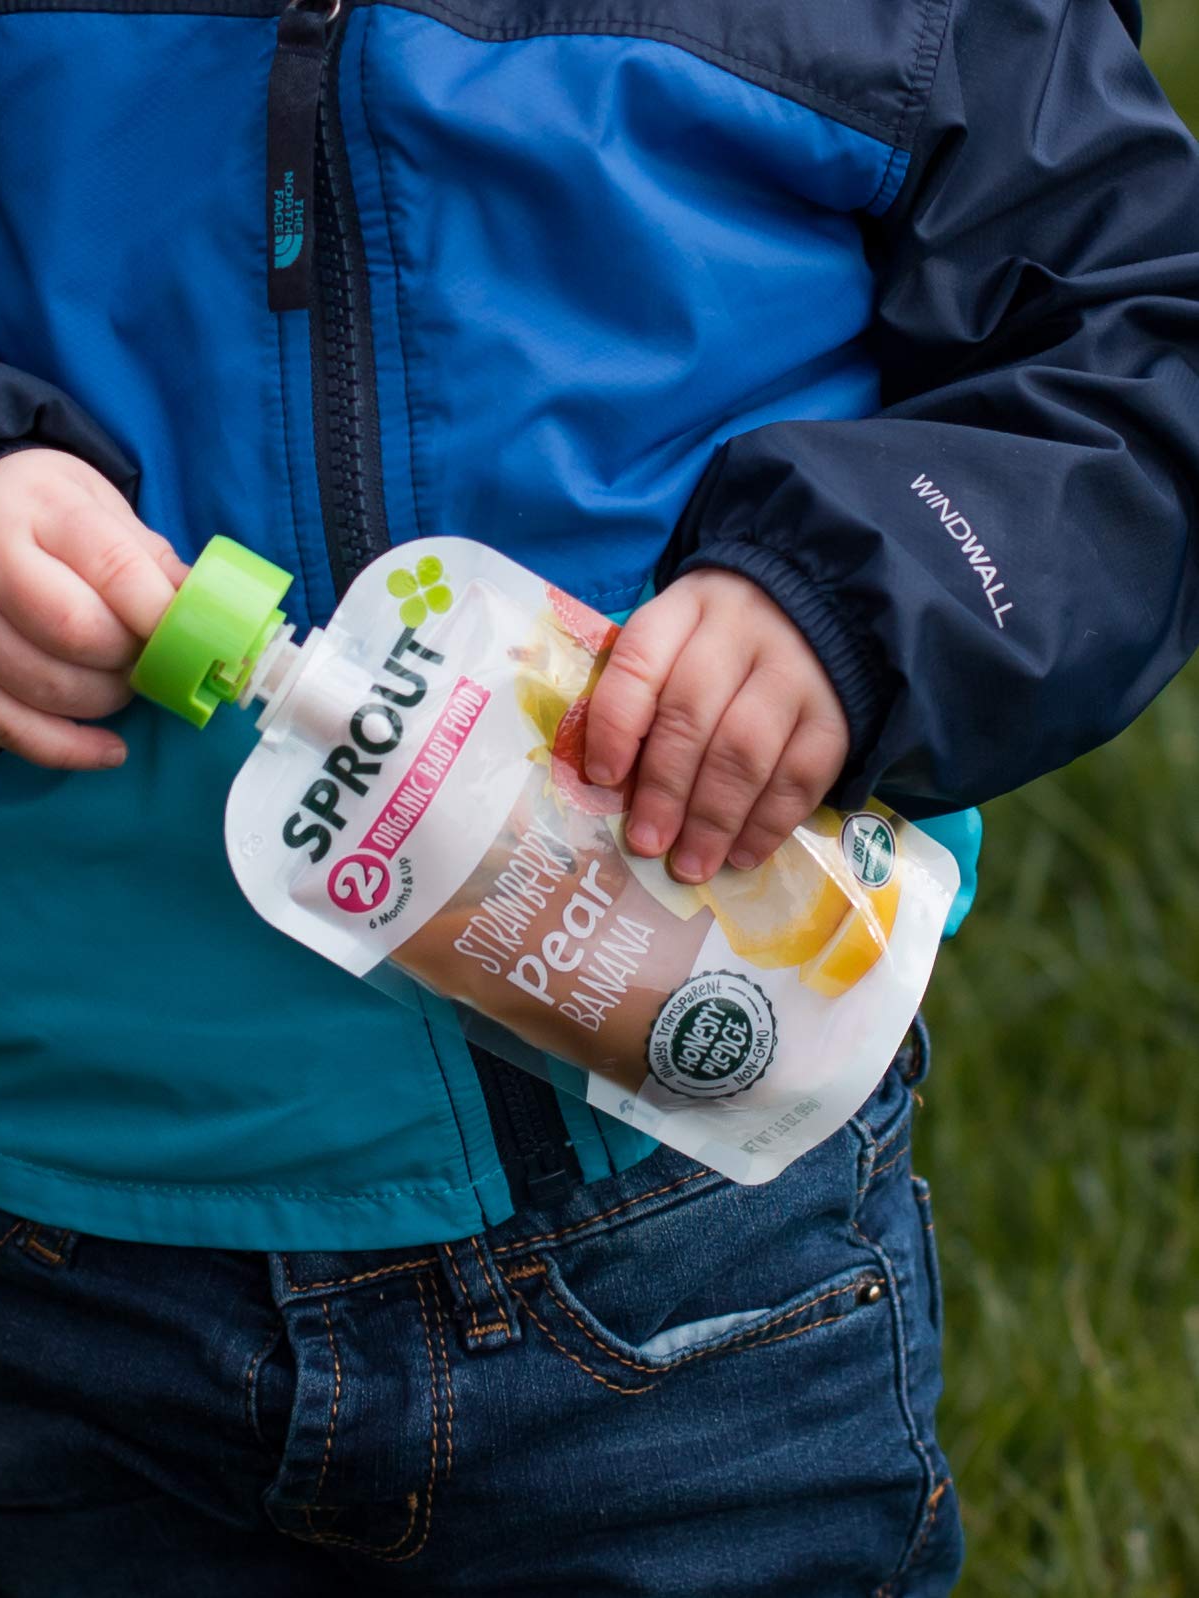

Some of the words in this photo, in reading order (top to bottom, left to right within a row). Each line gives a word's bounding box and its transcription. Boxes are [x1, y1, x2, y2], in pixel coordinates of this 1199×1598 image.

[274, 190, 284, 233] FACE
[284, 171, 294, 233] NORTH
[294, 199, 304, 234] THE
[910, 473, 1013, 629] WINDWALL
[282, 627, 445, 863] SPROUT
[371, 775, 433, 850] ORGANIC
[417, 731, 458, 782] BABY
[442, 687, 483, 738] FOOD
[334, 862, 384, 905] 2
[369, 918, 377, 929] 6
[379, 887, 412, 926] Months
[401, 876, 413, 885] &
[454, 816, 578, 975] STRAWBERRY
[506, 860, 613, 1007] pear
[558, 915, 655, 1032] BANANA
